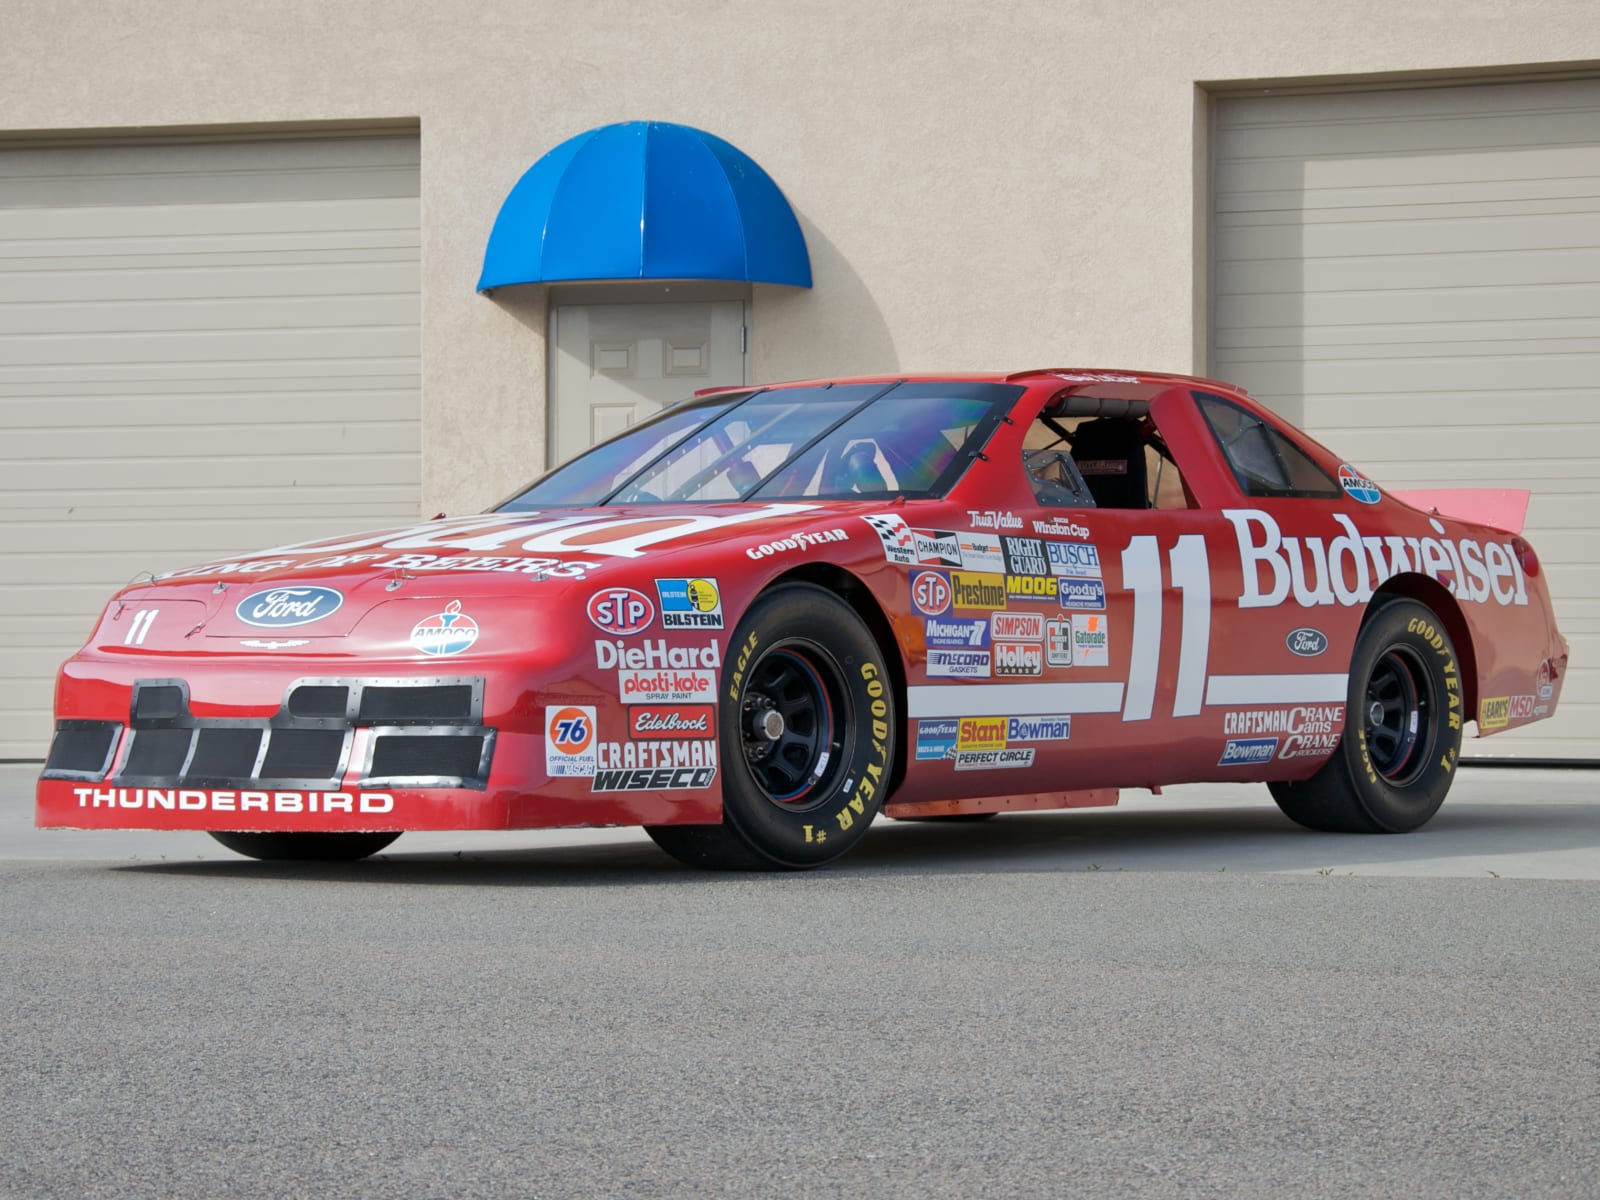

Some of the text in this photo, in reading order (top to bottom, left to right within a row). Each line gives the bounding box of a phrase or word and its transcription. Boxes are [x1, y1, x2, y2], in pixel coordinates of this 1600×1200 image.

[745, 528, 849, 560] GOODYEAR
[886, 544, 915, 556] Western
[917, 540, 958, 556] CHAMPION
[1005, 537, 1043, 557] RIGHT
[1046, 543, 1099, 566] BUSCH
[294, 553, 390, 570] OF
[894, 554, 910, 563] Auto
[1010, 556, 1047, 575] GUARD
[917, 576, 946, 608] STP
[952, 574, 1005, 606] Prestone
[1007, 575, 1058, 596] MOOG
[1061, 582, 1103, 599] Goody's
[253, 588, 317, 619] Ford
[596, 591, 645, 627] STP
[124, 609, 159, 645] 11
[664, 613, 722, 626] BILSTEIN
[926, 619, 970, 638] MICHIGAN
[995, 616, 1040, 637] SIMPSON
[1121, 534, 1212, 723] 11
[1075, 630, 1106, 644] Gatorade
[1293, 630, 1320, 653] Ford
[595, 639, 720, 669] DieHard
[996, 644, 1041, 673] Holley
[730, 631, 759, 701] EAGLE
[949, 666, 977, 674] GASKETS
[1407, 617, 1461, 731] GOODYEAR
[624, 671, 710, 694] plasti-kote
[671, 692, 692, 700] PAINT
[1510, 696, 1534, 718] MSD
[556, 718, 587, 743] 76
[634, 712, 708, 732] Edelbrock
[960, 719, 1006, 742] Stant
[1008, 717, 1069, 740] Bowman
[1224, 709, 1288, 735] CRAFTSMAN
[598, 740, 718, 769] CRAFTSMAN
[835, 661, 888, 831] GOODYEAR
[958, 751, 1032, 764] PERFECT CIRCLE
[1223, 742, 1275, 760] Bowman
[593, 768, 716, 791] WISECO
[74, 788, 394, 813] THUNDERBIRD
